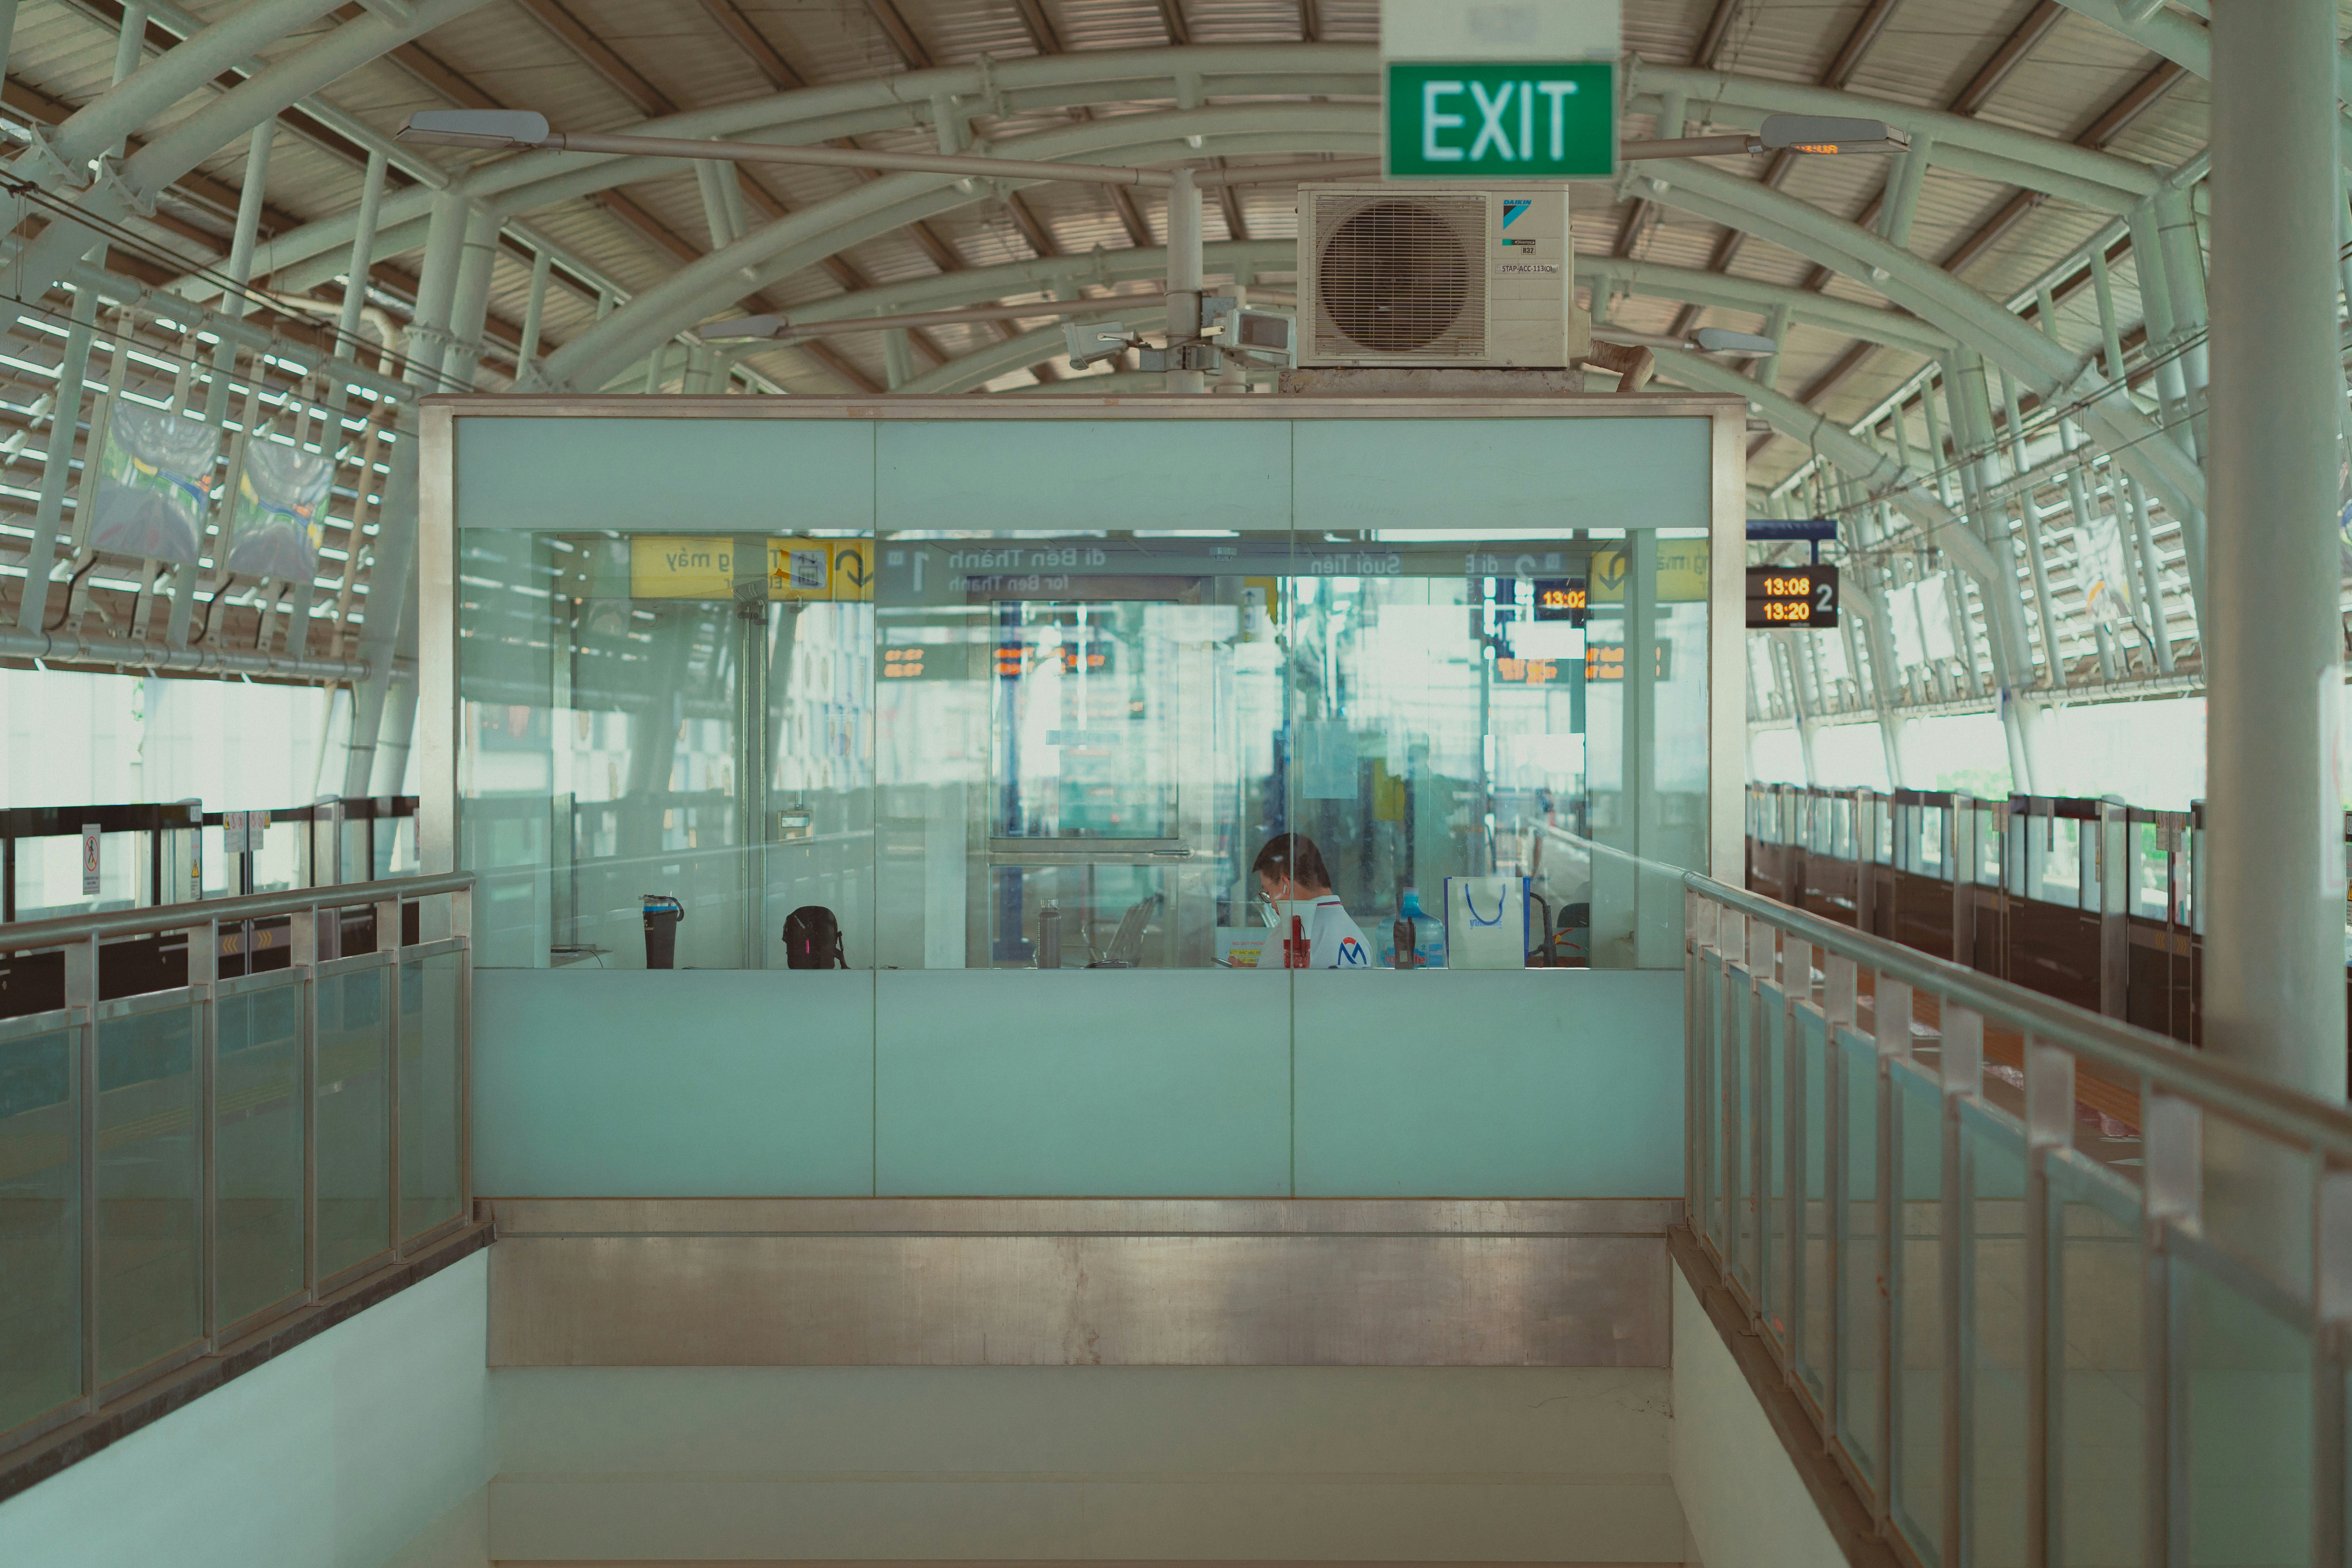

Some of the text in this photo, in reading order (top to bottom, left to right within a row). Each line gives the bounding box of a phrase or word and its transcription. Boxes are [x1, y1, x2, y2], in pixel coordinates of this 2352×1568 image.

[1423, 80, 1579, 161] EXIT
[1764, 577, 1810, 595] 13:08
[1816, 583, 1833, 612] 2
[1764, 603, 1810, 620] 13:20
